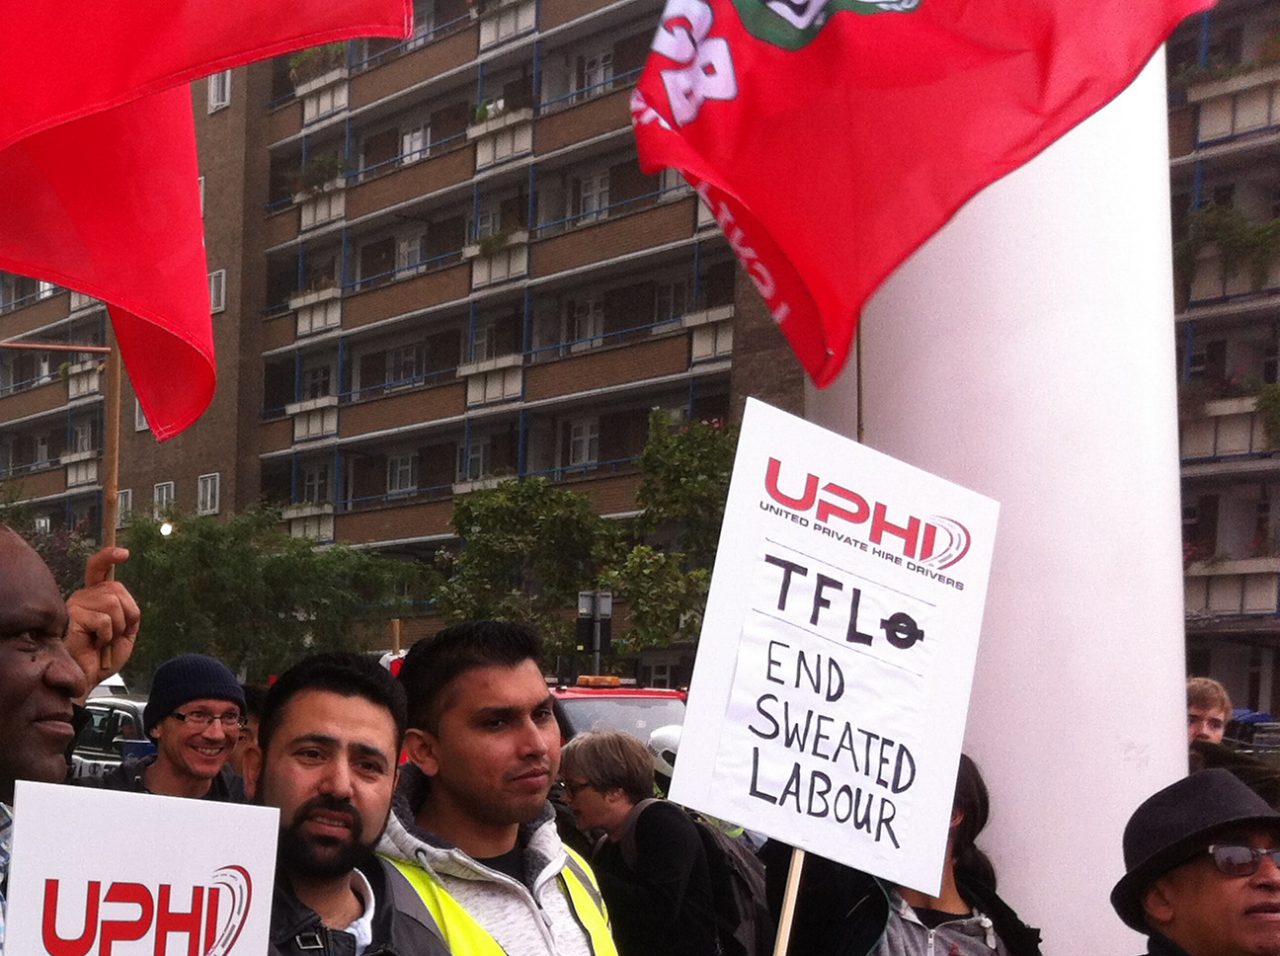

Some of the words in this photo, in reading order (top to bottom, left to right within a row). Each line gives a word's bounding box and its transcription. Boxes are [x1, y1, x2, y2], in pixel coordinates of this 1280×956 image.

[759, 500, 810, 528] UNITED
[813, 523, 868, 553] PRIVATE
[872, 547, 903, 566] HIRE
[906, 560, 965, 592] DRIVERS
[764, 456, 938, 562] UPHI
[764, 553, 874, 647] TFL
[766, 639, 845, 702] END
[748, 693, 916, 794] SWEATED
[748, 746, 901, 849] LABOUR
